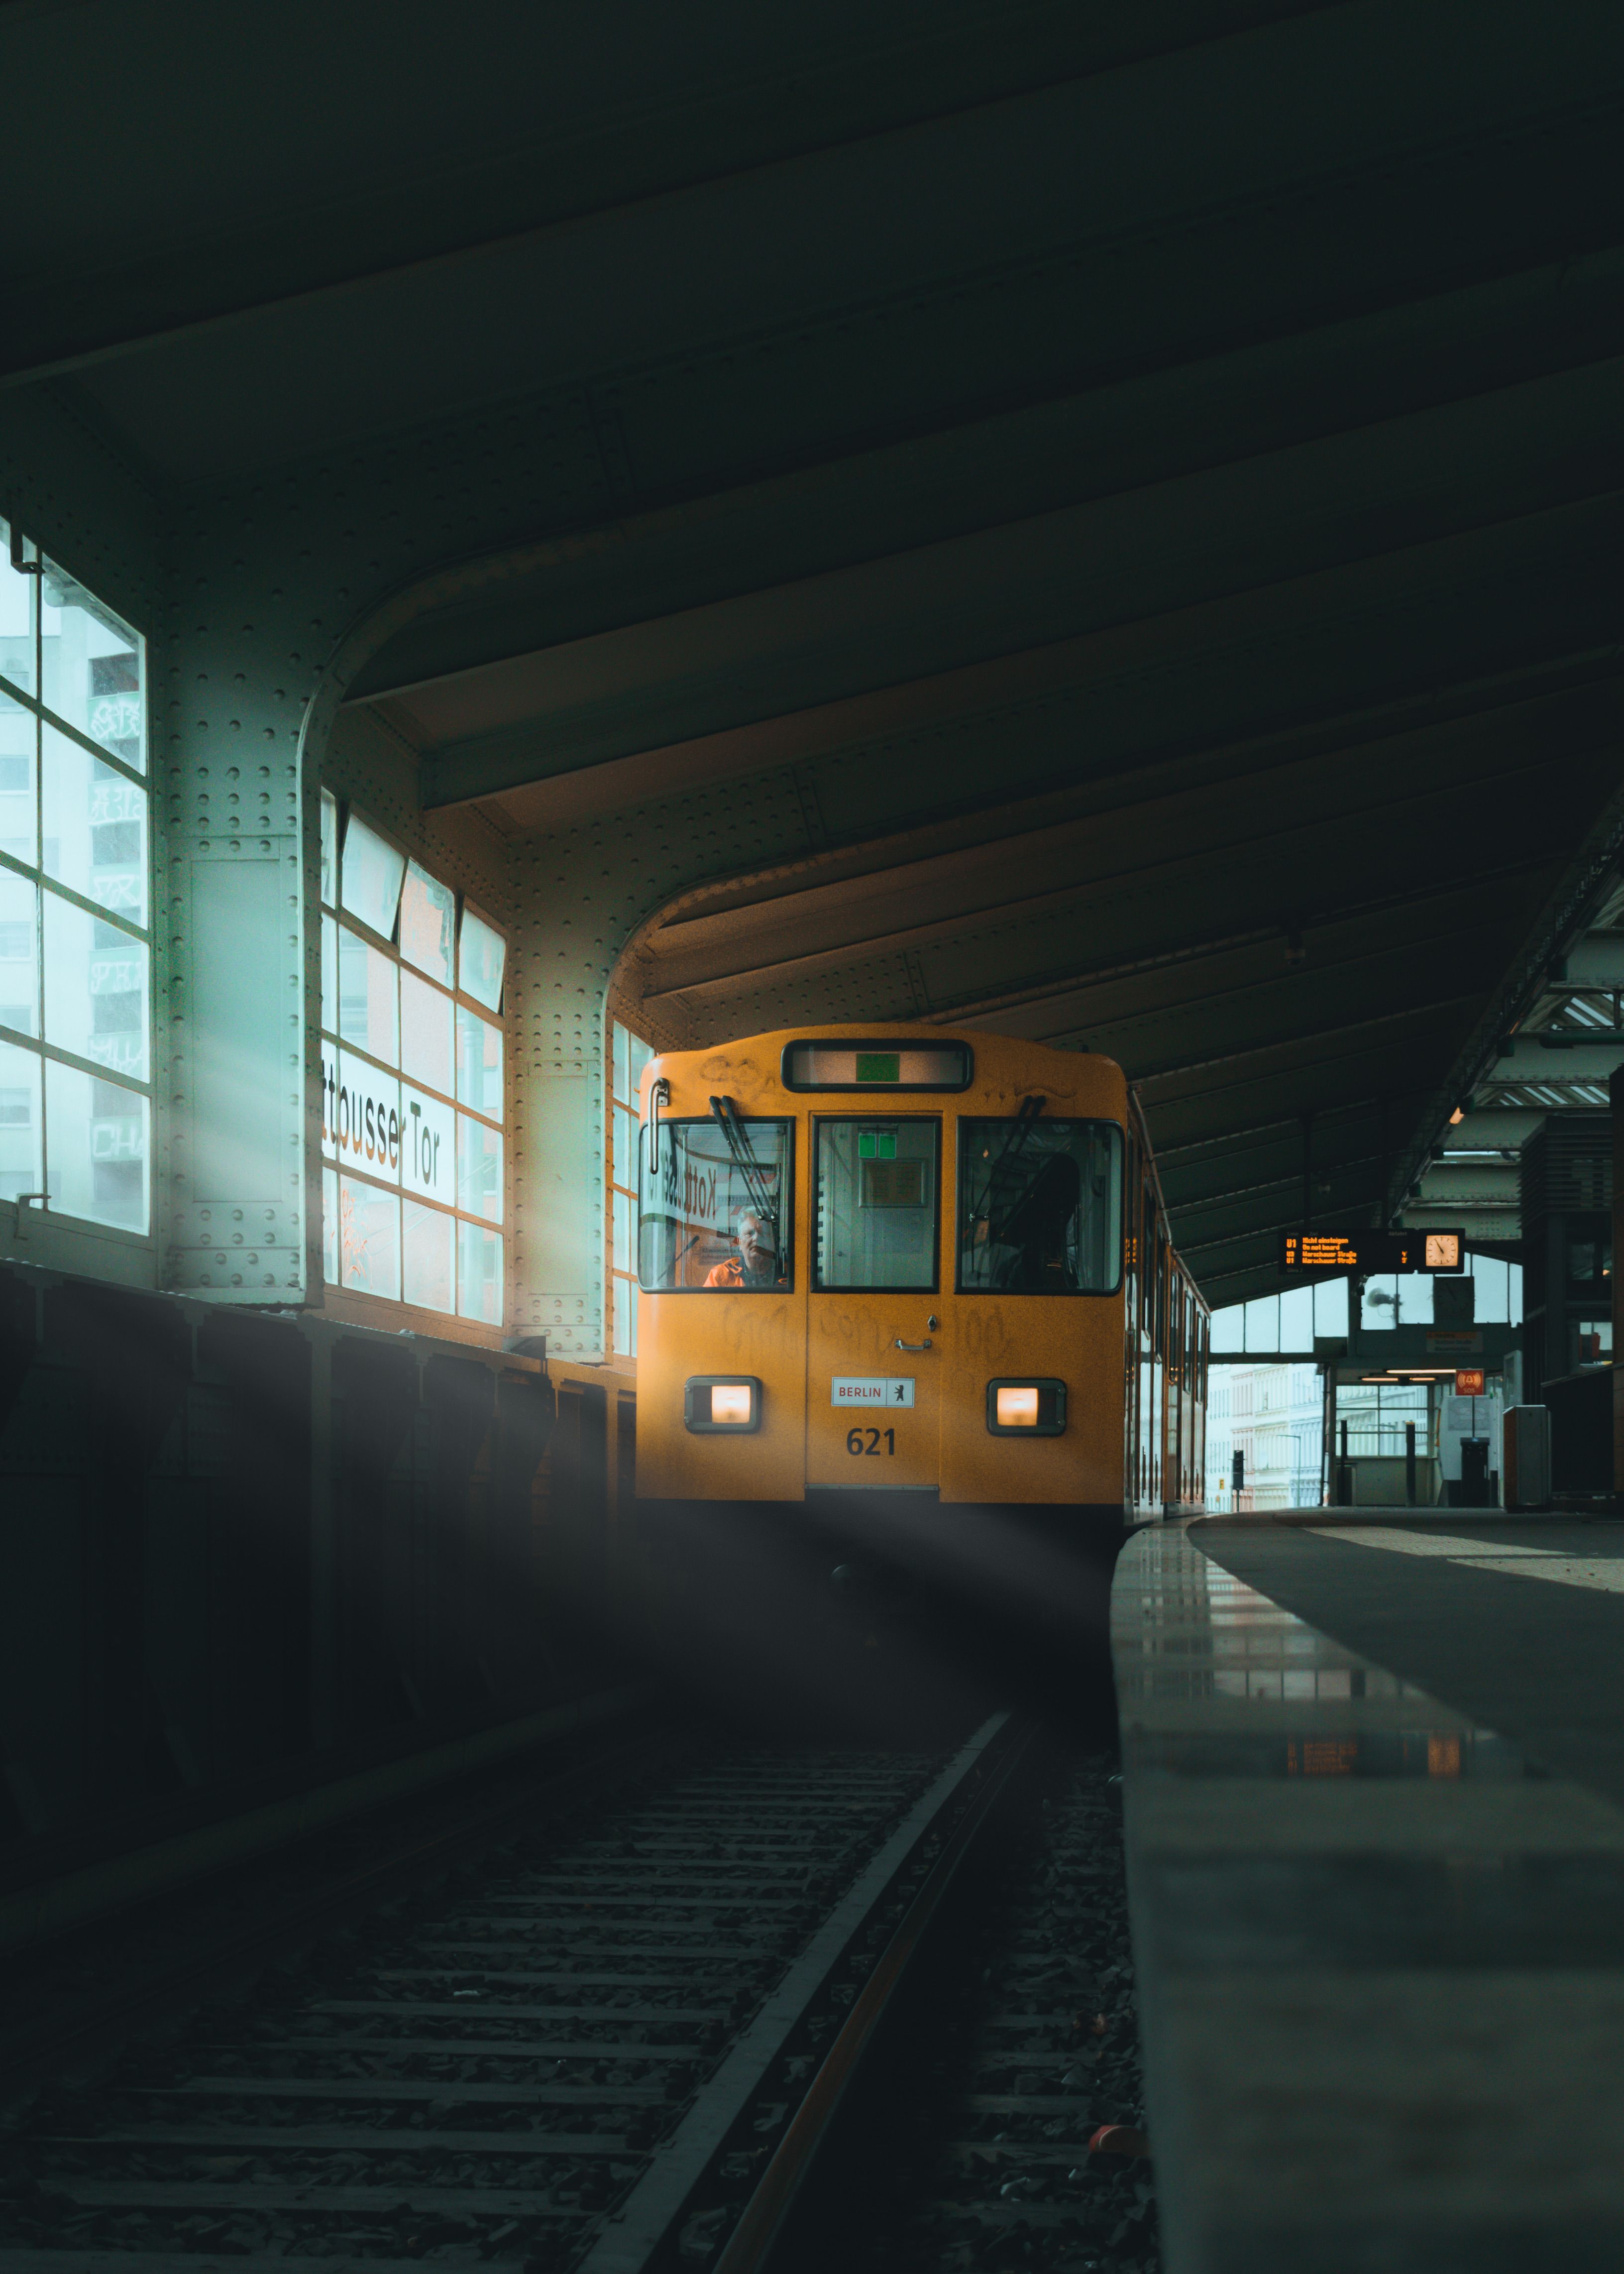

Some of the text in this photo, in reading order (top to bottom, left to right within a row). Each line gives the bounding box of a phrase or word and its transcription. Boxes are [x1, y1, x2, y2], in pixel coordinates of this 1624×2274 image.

[410, 1101, 439, 1187] Tor
[1286, 1239, 1297, 1248] U1
[839, 1387, 881, 1397] BERLIN
[847, 1427, 895, 1456] 621
